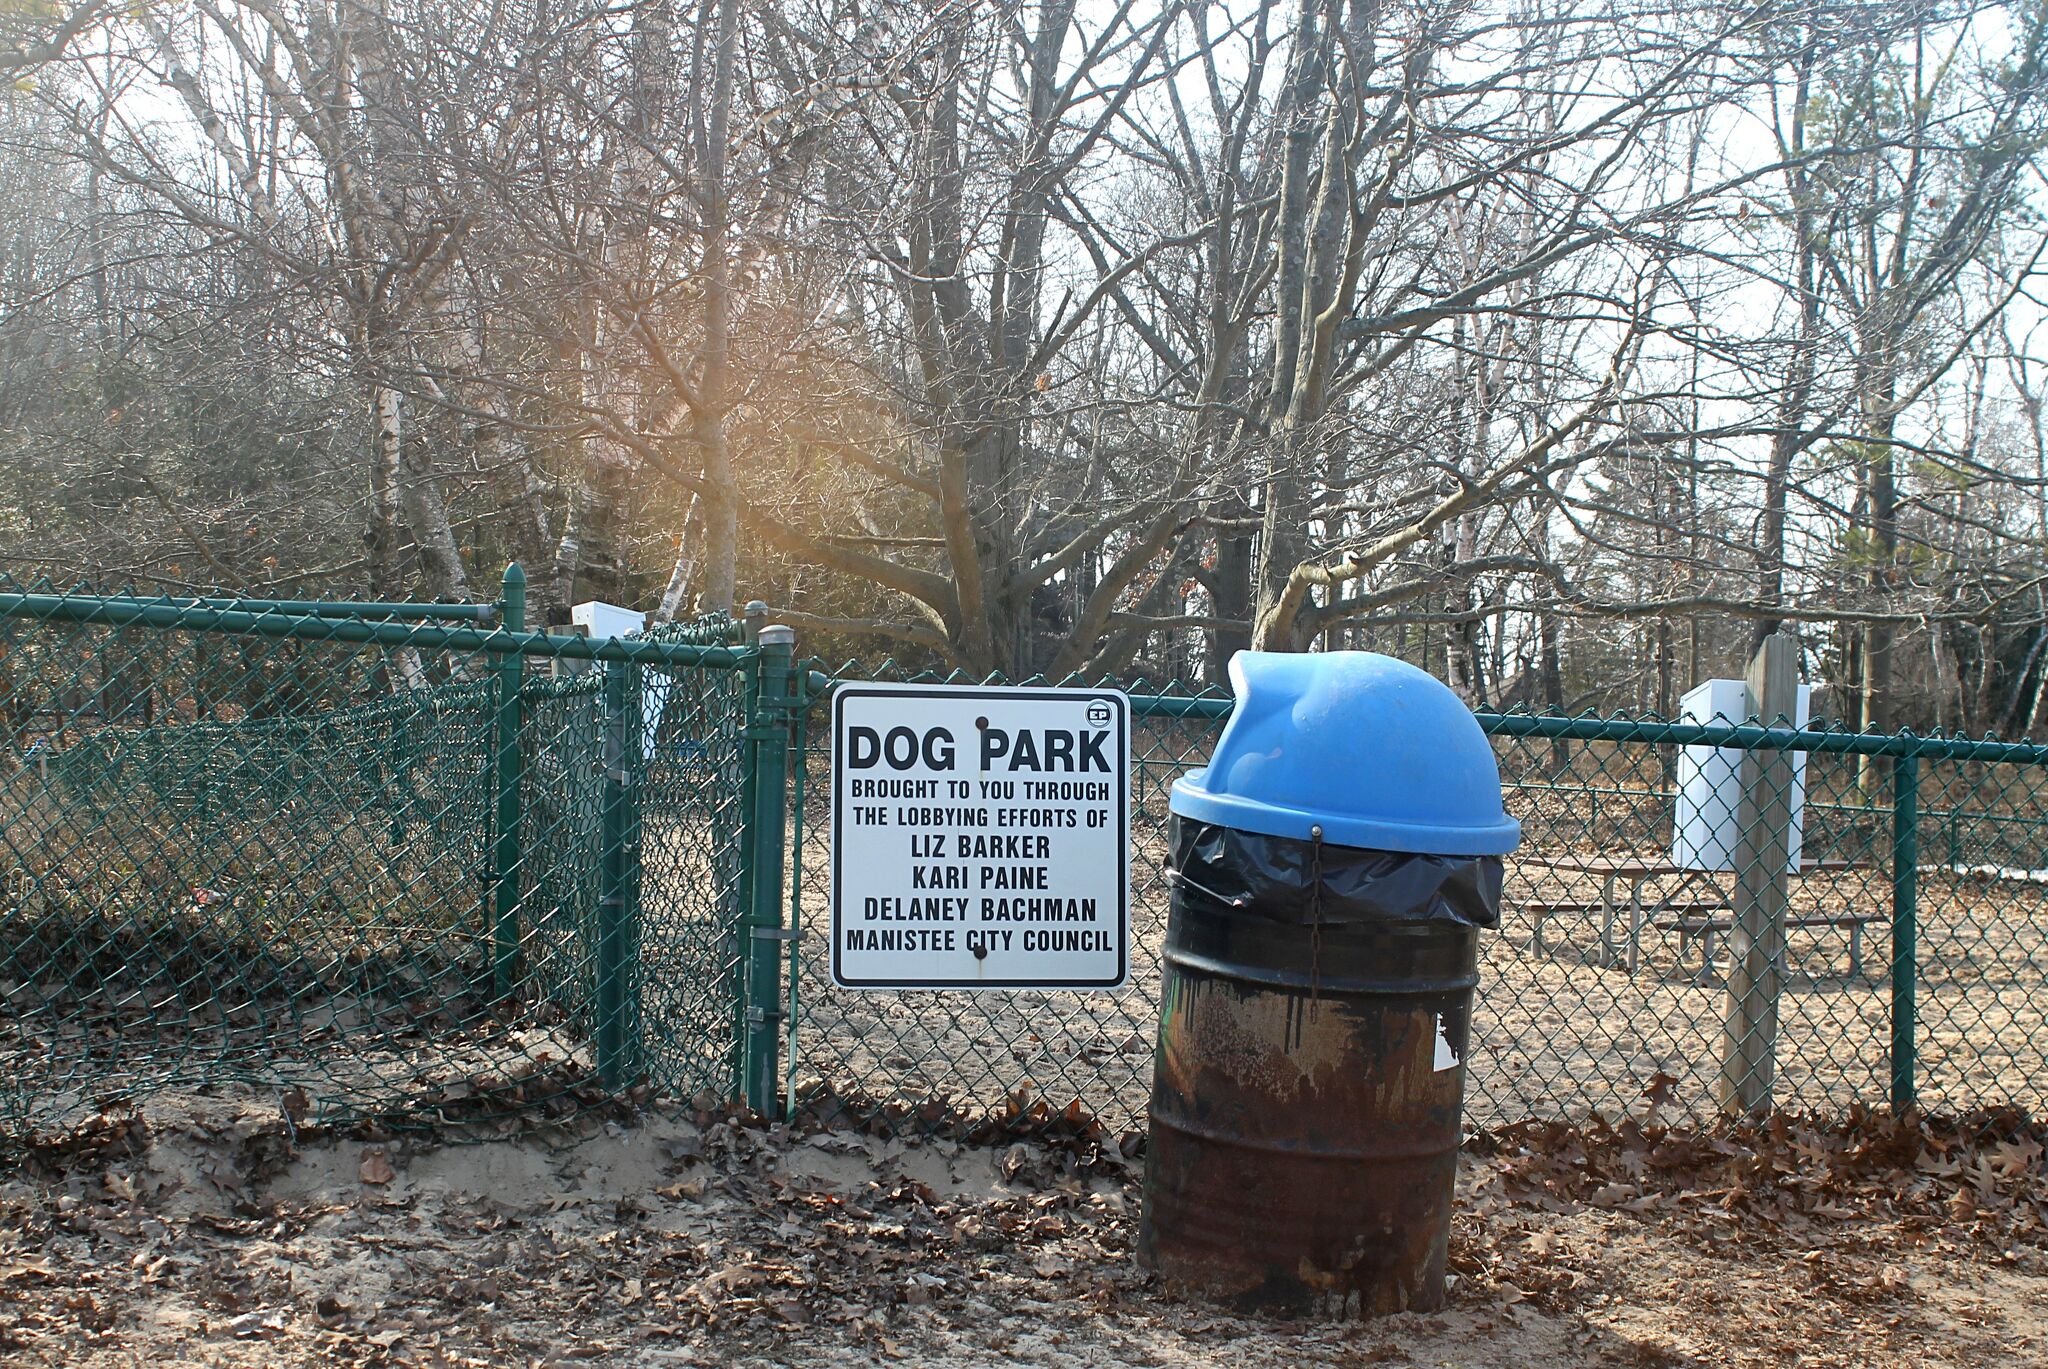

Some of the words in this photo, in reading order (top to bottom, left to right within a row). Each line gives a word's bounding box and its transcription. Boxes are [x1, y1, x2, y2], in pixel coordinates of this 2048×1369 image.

[1089, 710, 1107, 719] EP
[849, 726, 955, 770] DOG
[980, 729, 1112, 772] PARK
[852, 780, 938, 798] BROUGHT
[948, 781, 970, 799] TO
[979, 781, 1014, 799] YOU
[1024, 782, 1109, 800] THROUGH
[853, 807, 888, 825] THE
[898, 808, 988, 826] LOBBYING
[999, 809, 1076, 827] EFFORTS
[1087, 809, 1108, 828] OF
[912, 835, 946, 857] LIZ
[958, 836, 1049, 858] BARKER
[913, 866, 968, 889] KARI
[981, 867, 1048, 890] PAINE
[865, 898, 969, 921] DELANEY
[981, 898, 1096, 921] BACHMAN
[847, 930, 955, 950] MANISTEE
[966, 930, 1014, 951] CITY
[1024, 930, 1112, 951] COUNCIL
